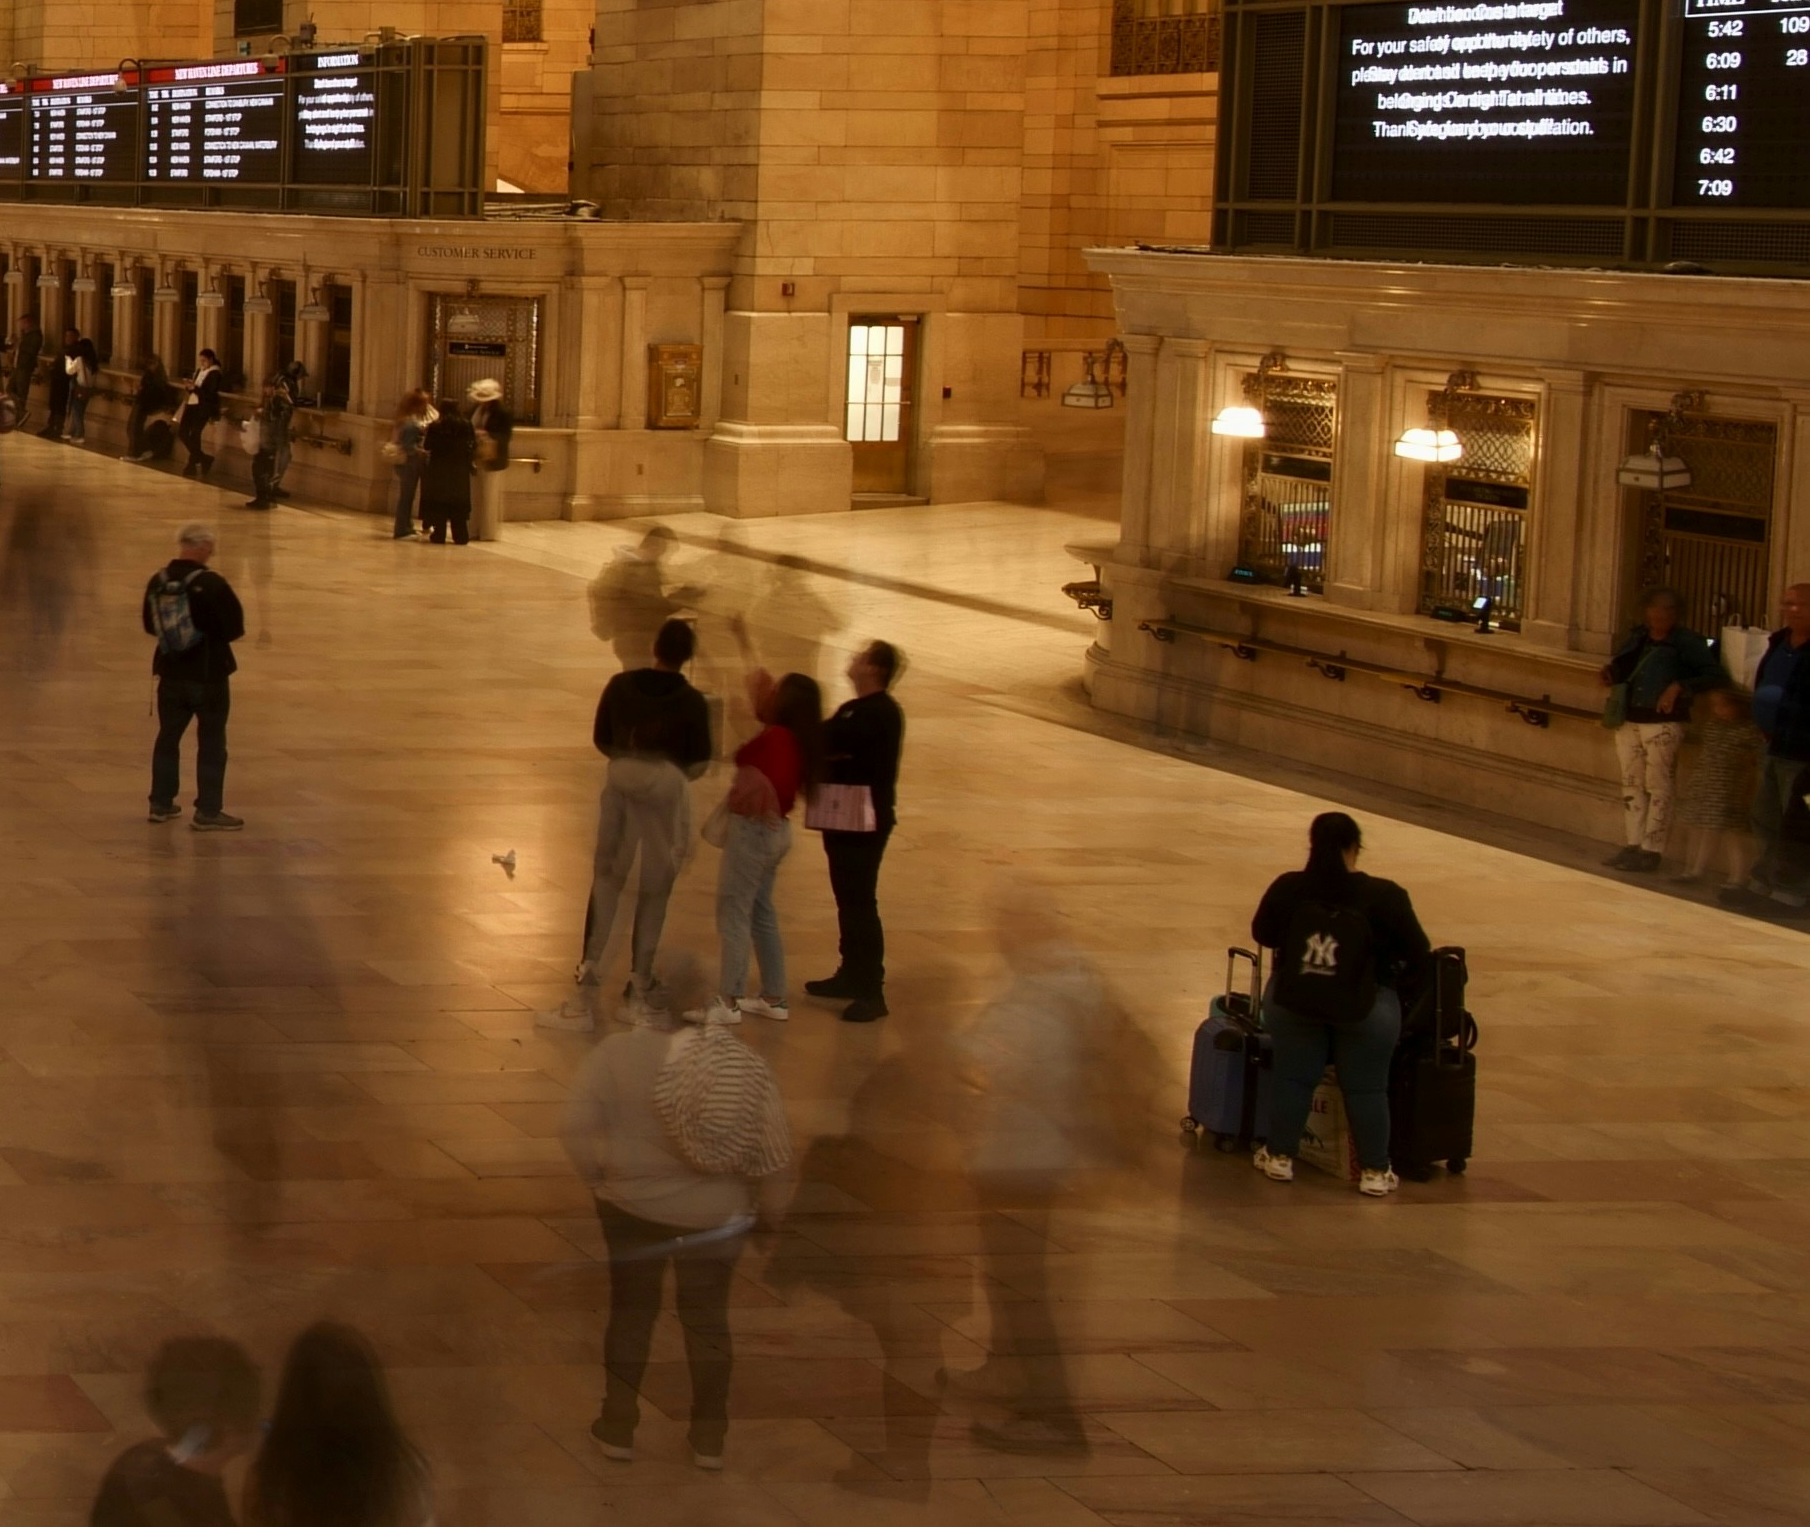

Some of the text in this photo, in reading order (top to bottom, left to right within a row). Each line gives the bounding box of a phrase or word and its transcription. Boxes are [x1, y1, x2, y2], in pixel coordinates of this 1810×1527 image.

[1708, 17, 1809, 37] 5:42 109
[1377, 38, 1407, 57] your
[1558, 29, 1573, 44] of
[1577, 27, 1630, 45] others,
[1706, 49, 1808, 69] 6:09 28
[1705, 84, 1737, 101] 6:11
[1702, 116, 1736, 132] 6:30
[1700, 148, 1734, 164] 6:42
[1698, 180, 1732, 196] 7:09
[417, 247, 537, 259] CUSTOMER SERVICE
[1302, 933, 1339, 966] NY
